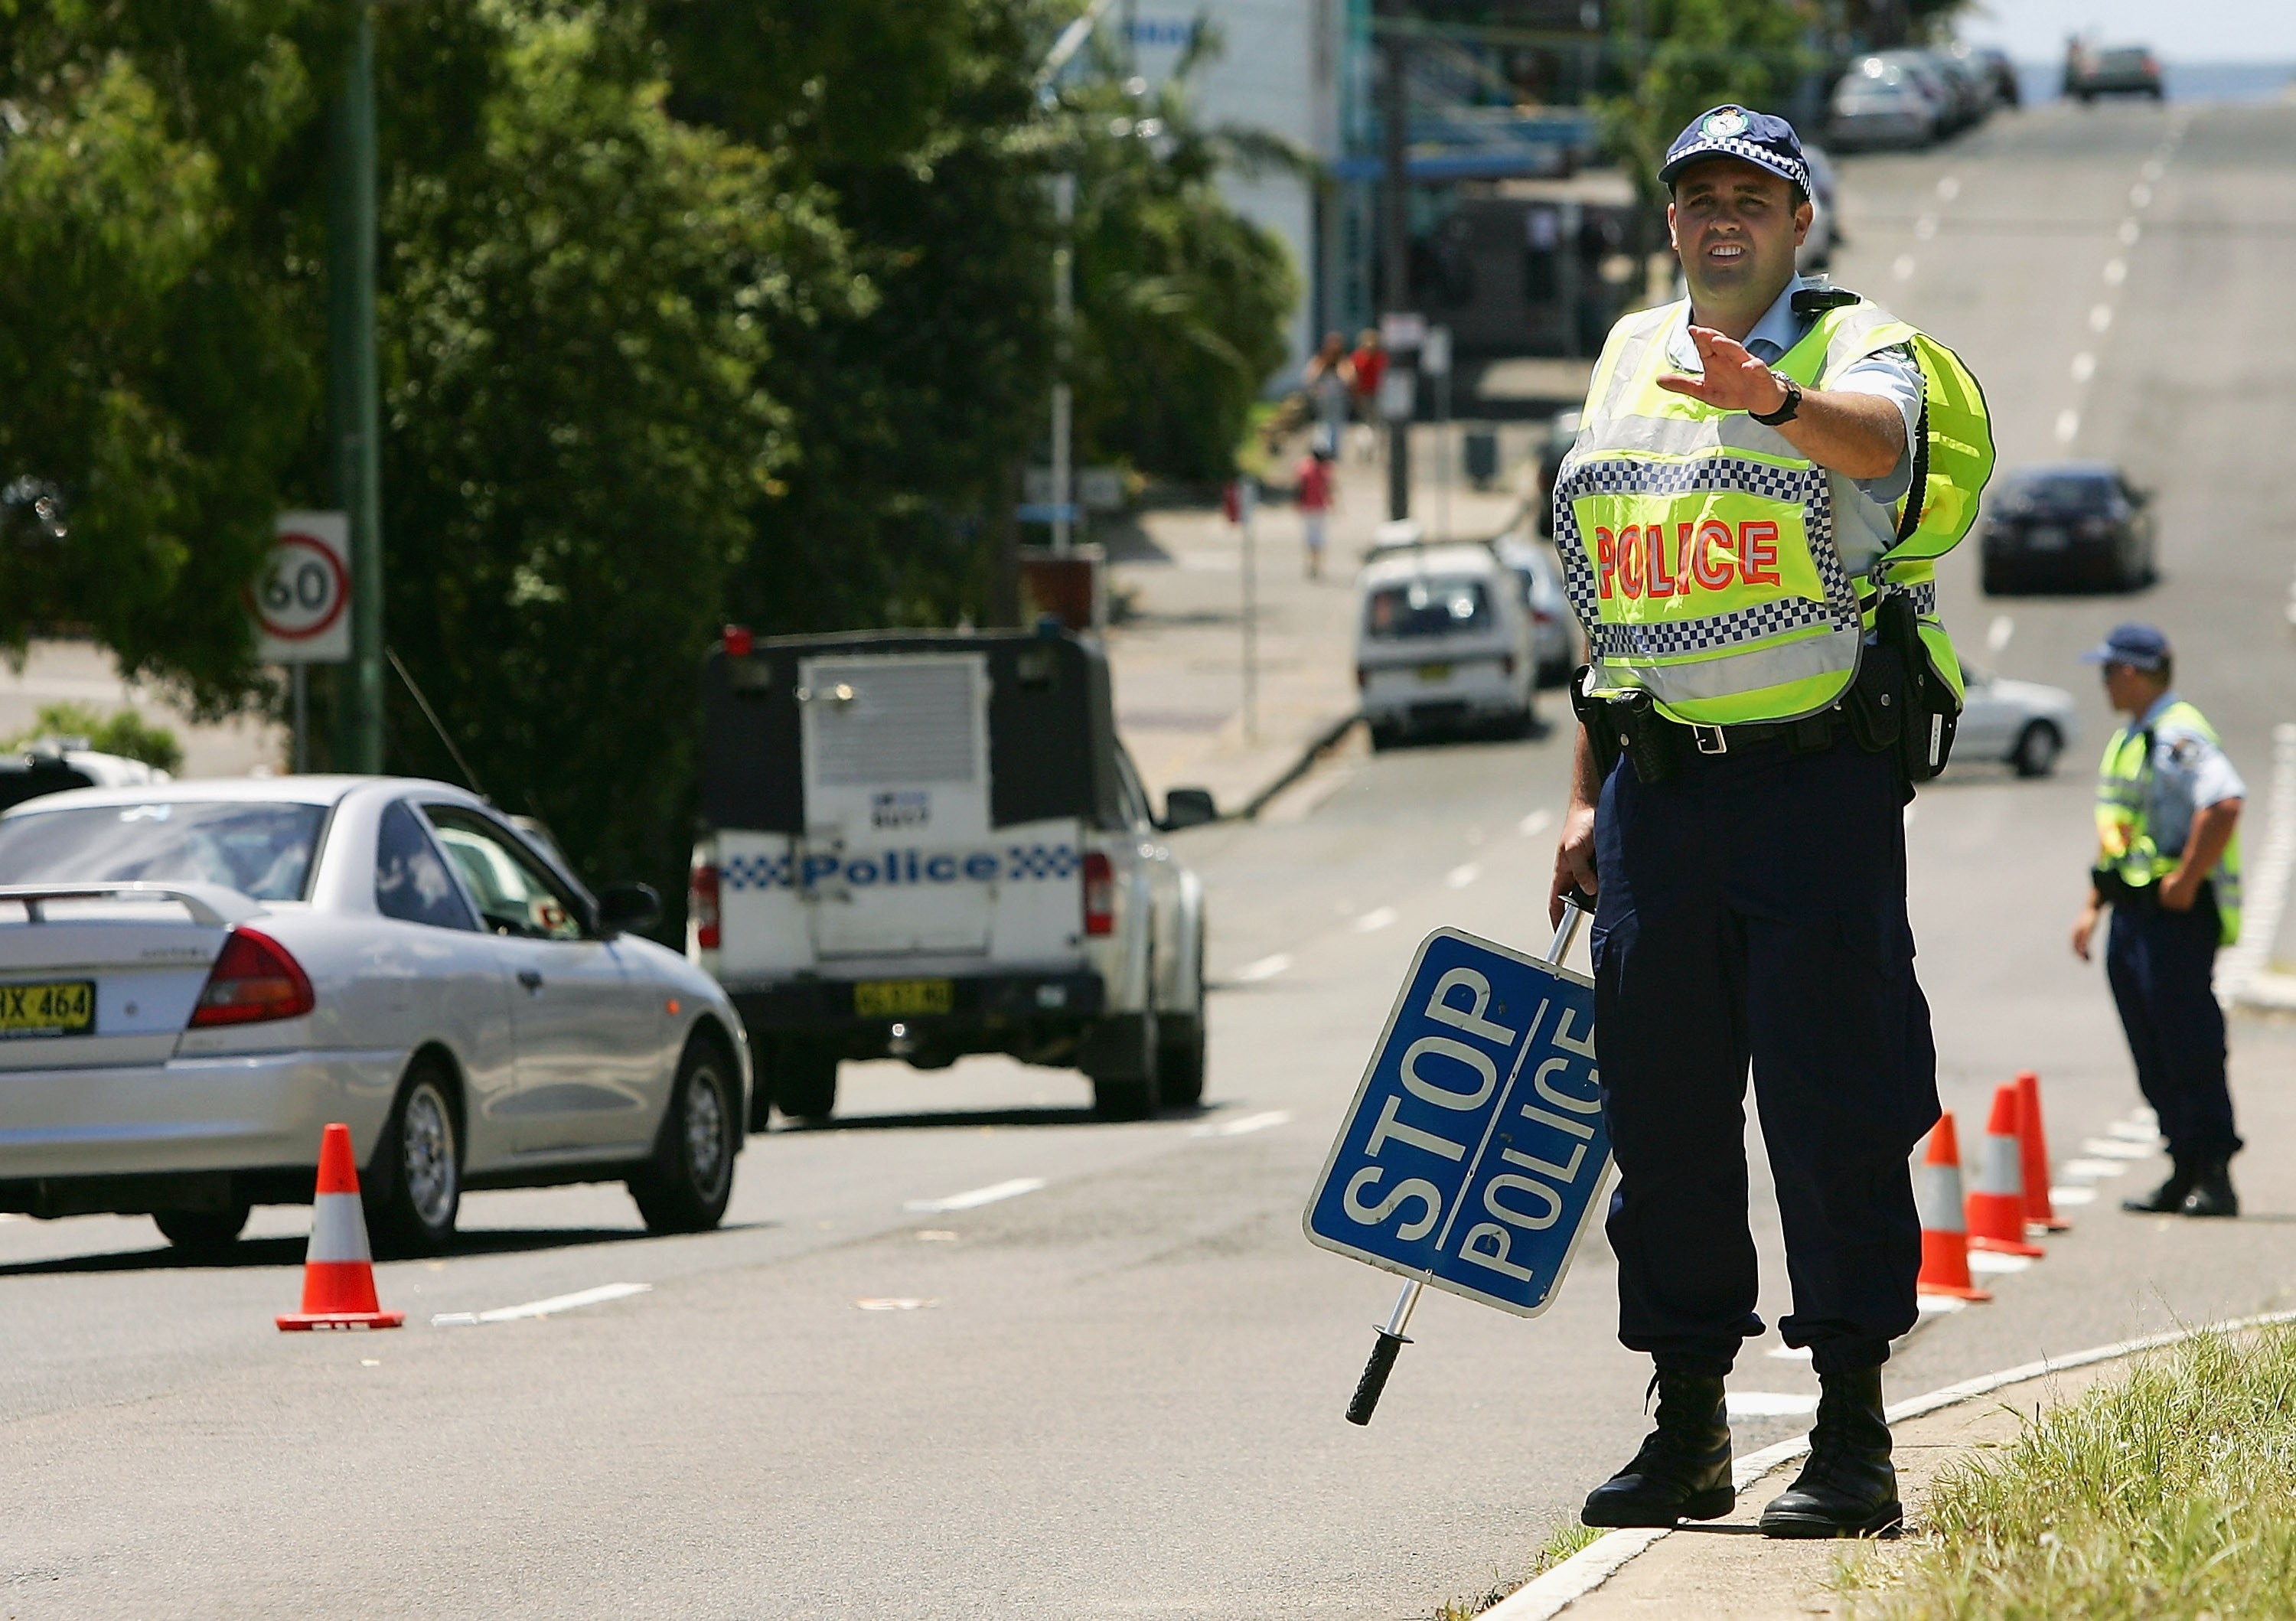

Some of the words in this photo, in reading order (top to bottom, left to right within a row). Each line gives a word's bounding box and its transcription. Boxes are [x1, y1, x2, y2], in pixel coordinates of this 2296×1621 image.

[263, 560, 328, 612] 60
[1595, 520, 1781, 600] POLICE
[803, 849, 998, 888] Police
[39, 987, 86, 1017] 464
[1343, 967, 1517, 1241] STOP
[1459, 1007, 1603, 1283] POLICE
